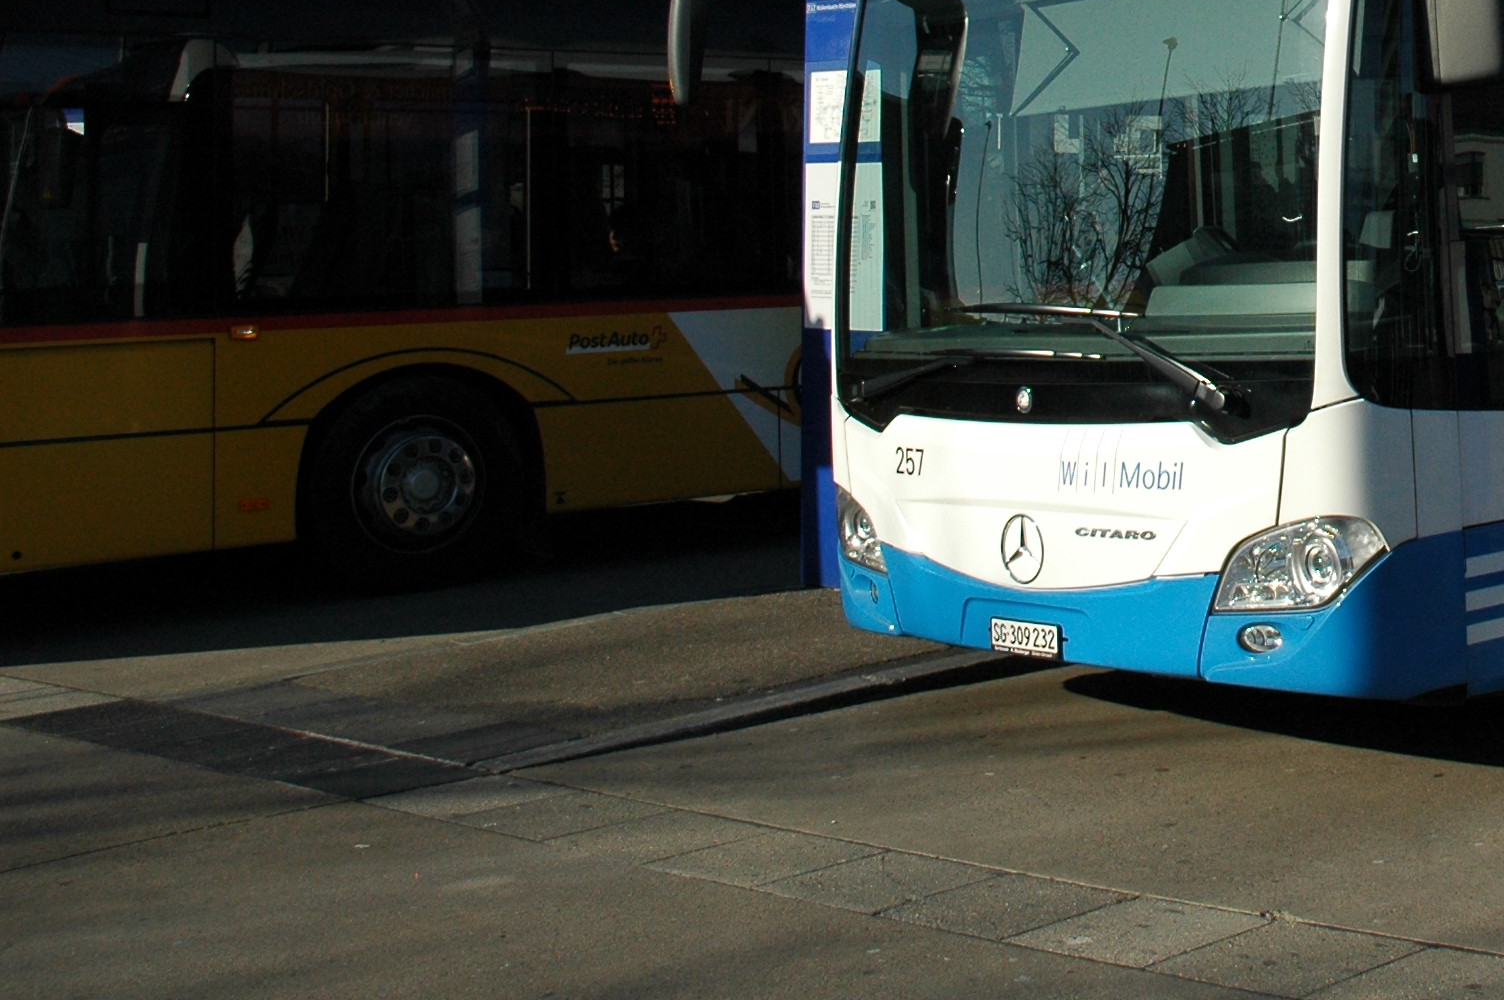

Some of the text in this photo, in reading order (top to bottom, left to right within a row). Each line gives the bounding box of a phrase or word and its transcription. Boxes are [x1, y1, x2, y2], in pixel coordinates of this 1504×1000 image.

[569, 331, 650, 350] PostAuto
[896, 446, 925, 478] 257
[1119, 460, 1184, 491] Mobil
[1075, 526, 1157, 541] CITARO
